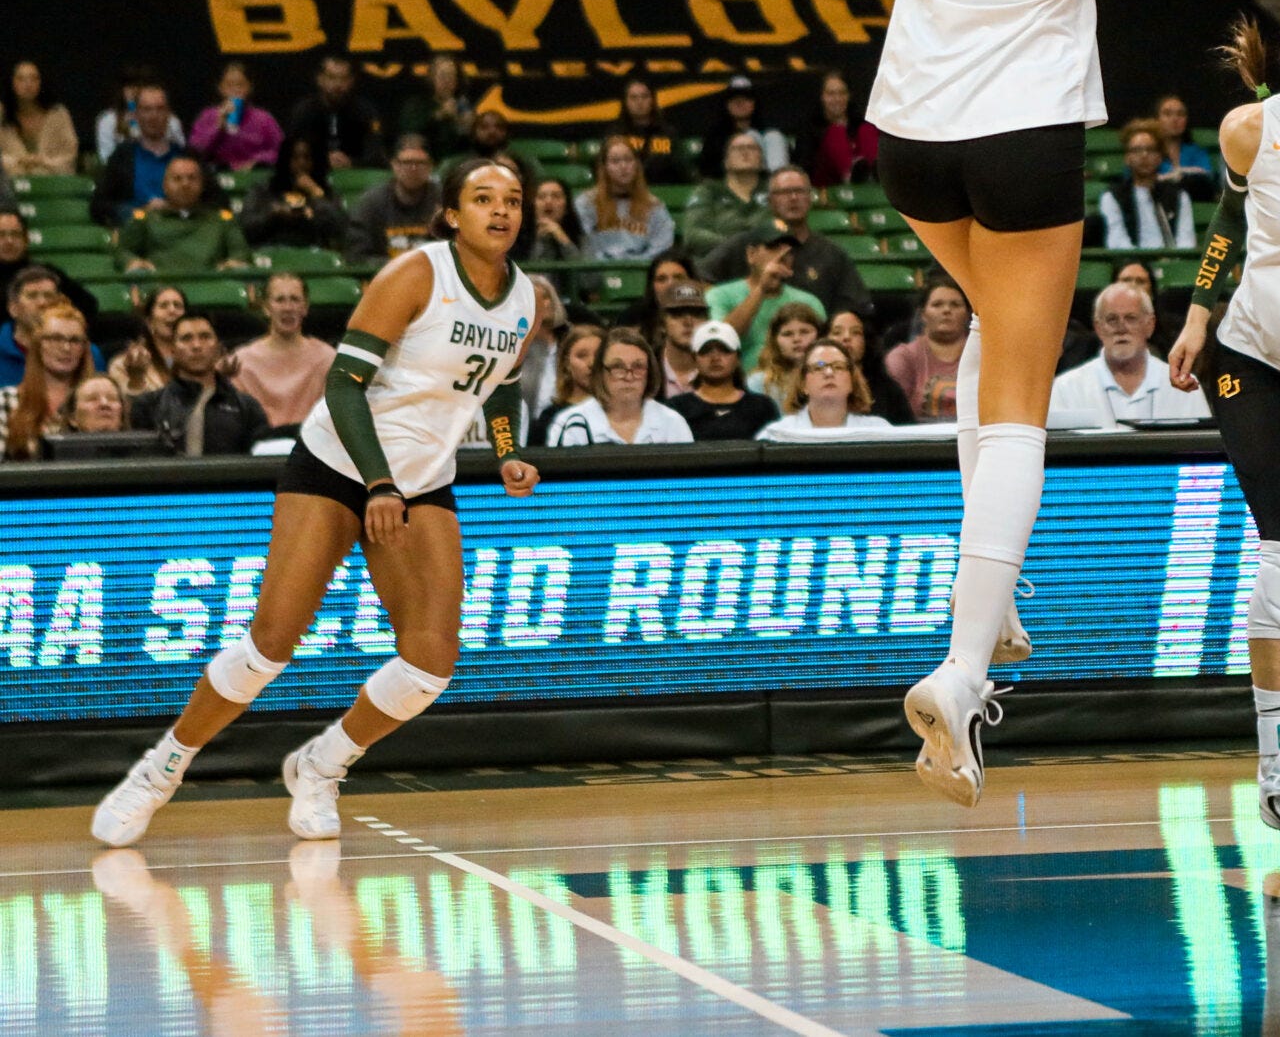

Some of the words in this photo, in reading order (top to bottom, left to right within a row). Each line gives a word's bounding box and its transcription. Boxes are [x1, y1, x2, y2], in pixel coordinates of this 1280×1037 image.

[1196, 233, 1233, 290] SIC'EM
[450, 321, 518, 354] BAYLOR
[453, 354, 498, 396] 31
[491, 416, 514, 459] BEARS
[602, 533, 958, 643] ROUND
